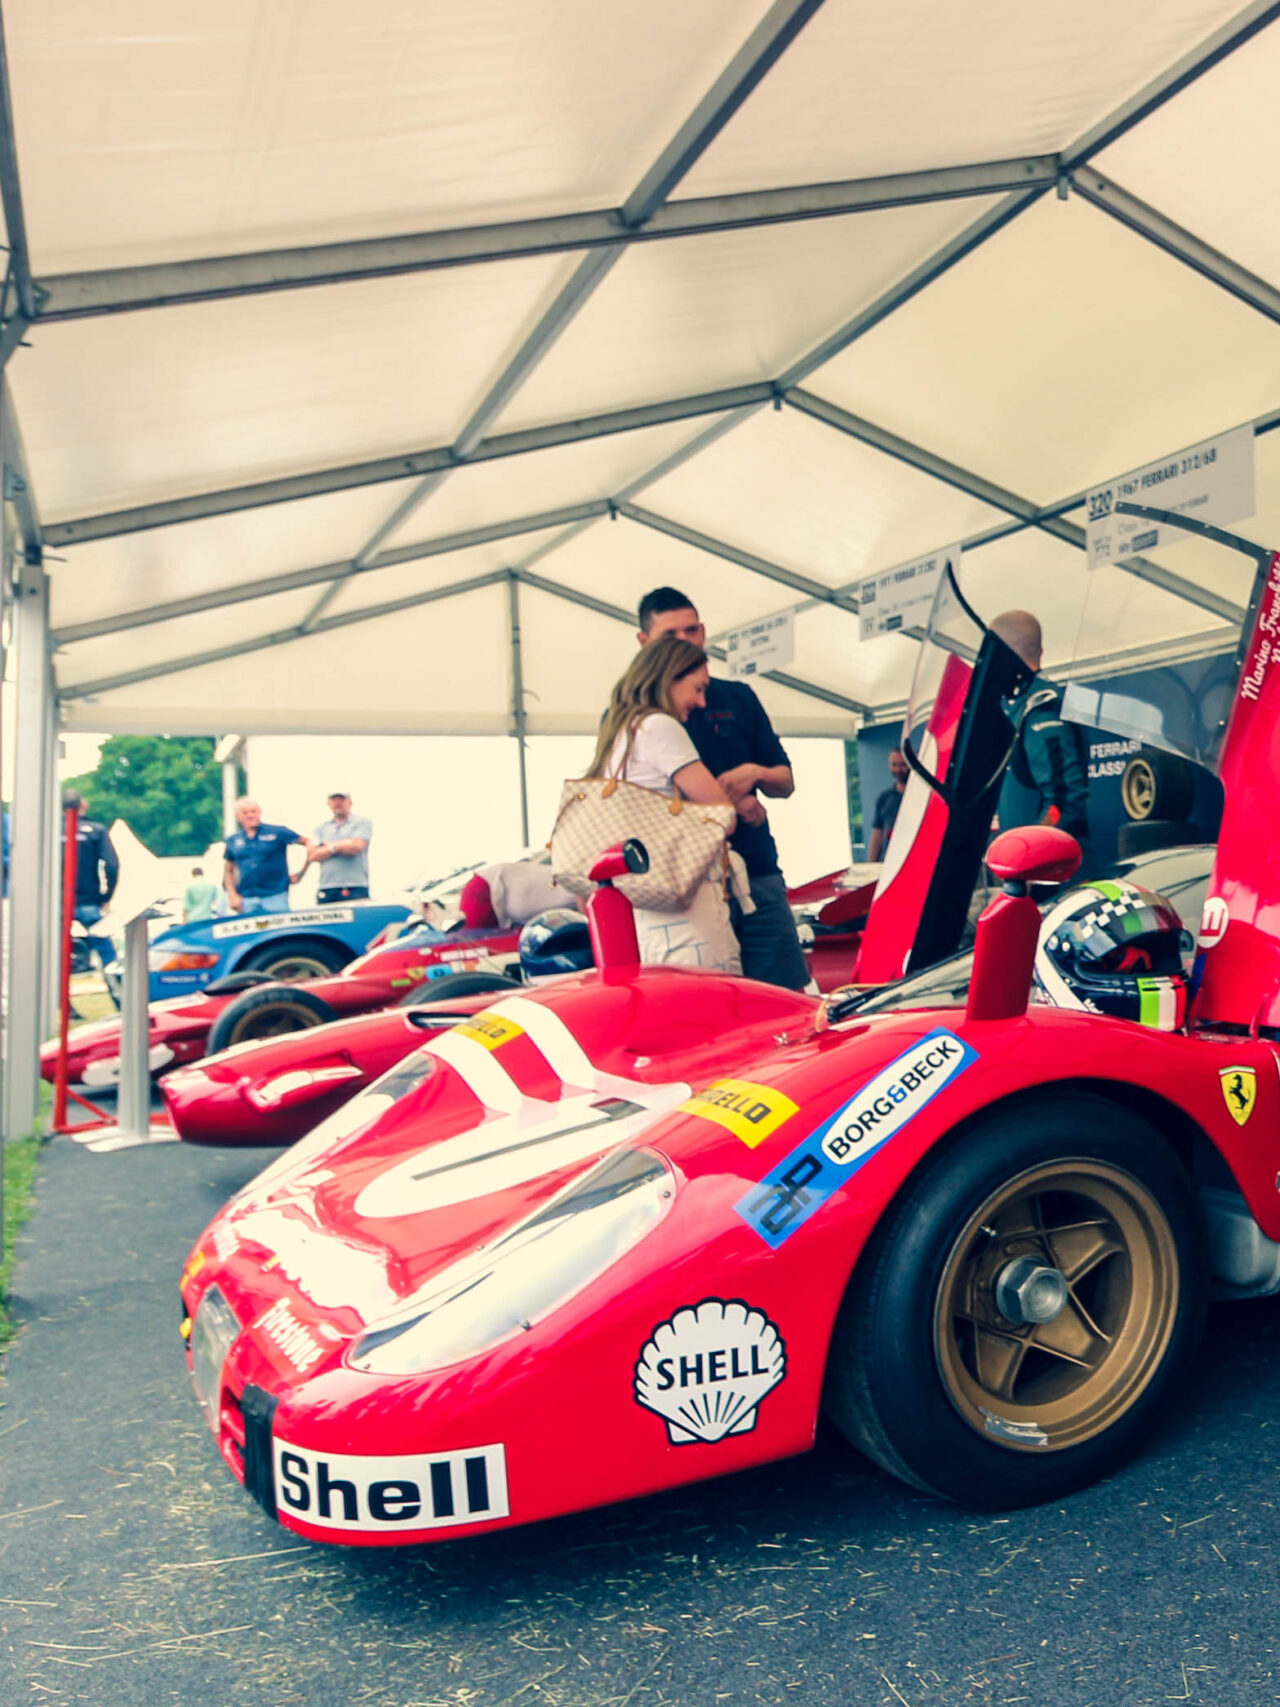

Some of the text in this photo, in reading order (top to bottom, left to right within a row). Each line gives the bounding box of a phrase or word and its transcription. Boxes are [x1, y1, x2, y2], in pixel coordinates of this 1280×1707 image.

[1141, 463, 1178, 488] FERRARI
[1089, 489, 1113, 516] 320
[1241, 639, 1272, 700] Marino
[1089, 739, 1142, 759] FERRARI
[656, 1344, 769, 1391] SHELL
[281, 1450, 490, 1522] Shell
